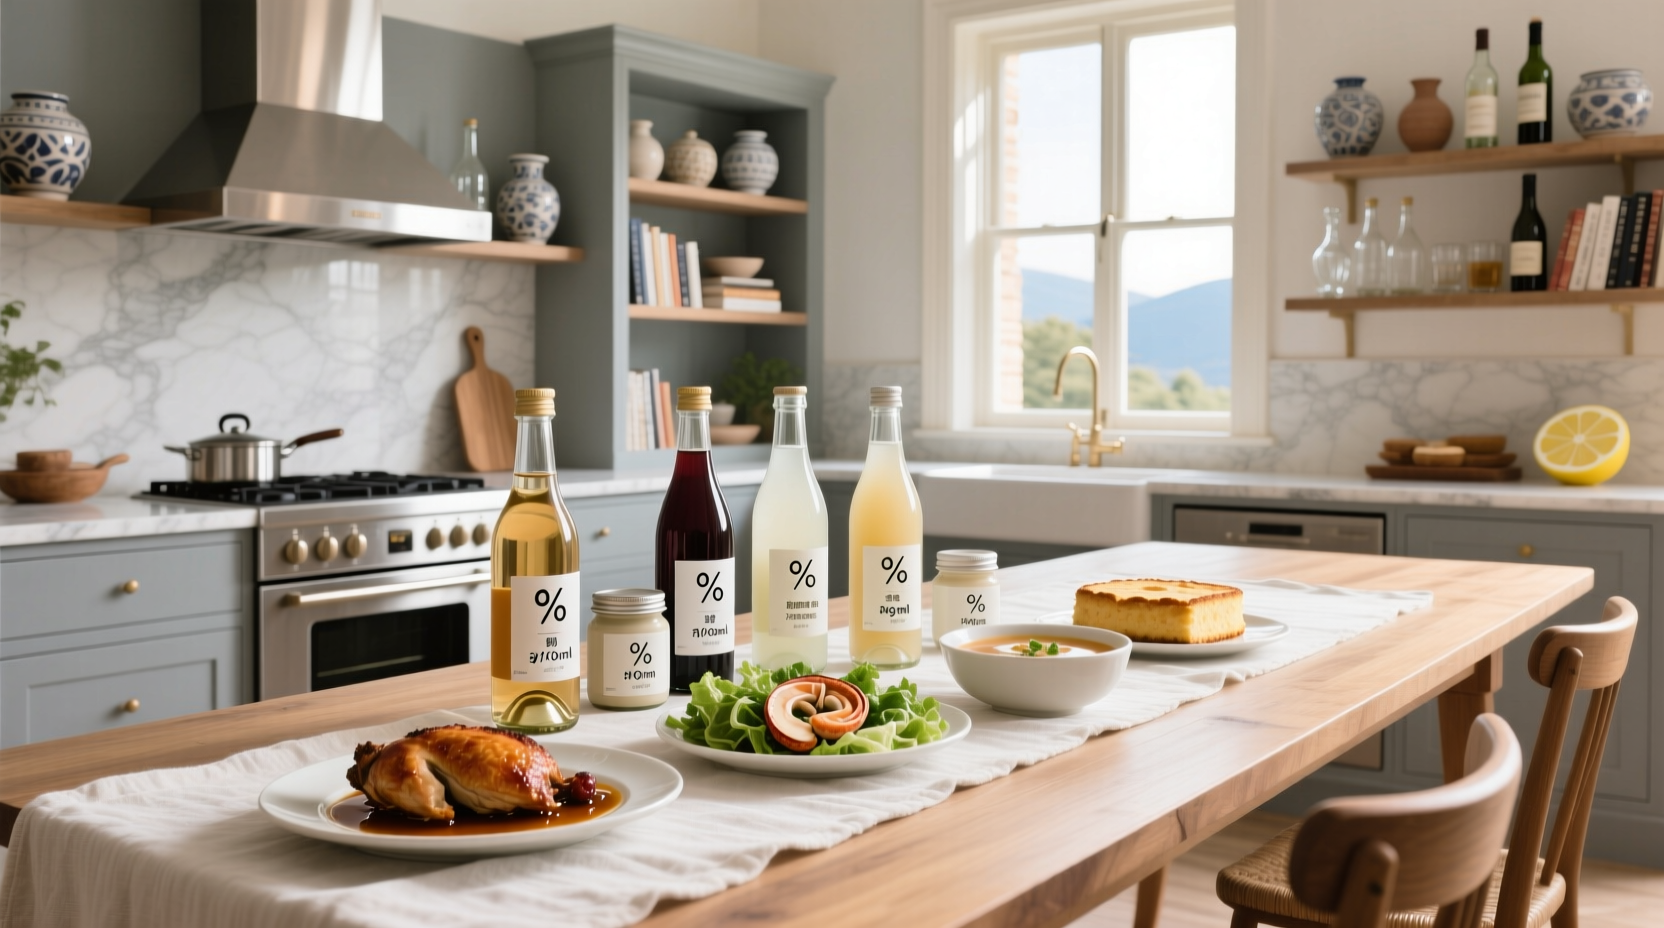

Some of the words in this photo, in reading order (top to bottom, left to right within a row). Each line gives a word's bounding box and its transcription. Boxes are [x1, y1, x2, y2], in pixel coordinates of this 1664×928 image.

[789, 559, 816, 591] %
[881, 555, 908, 585] %
[696, 571, 724, 604] %
[534, 587, 567, 625] %
[966, 594, 986, 614] %
[629, 641, 652, 666] %
